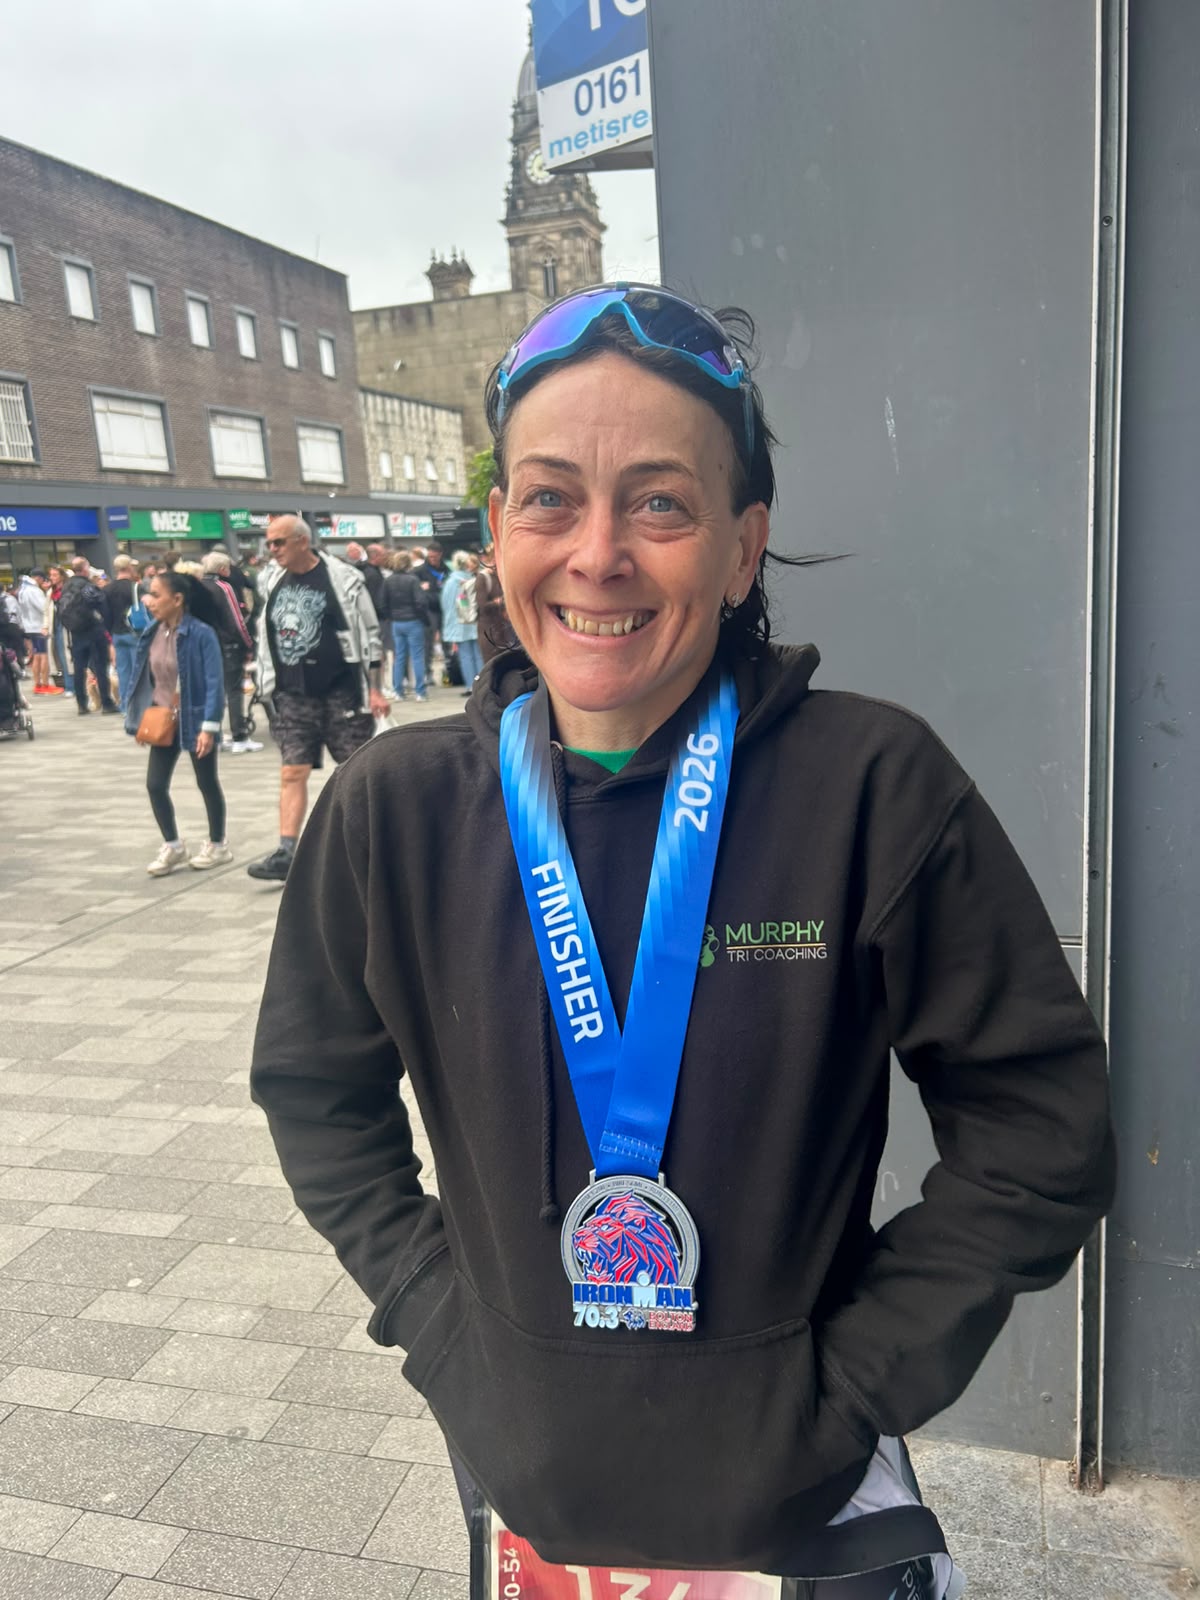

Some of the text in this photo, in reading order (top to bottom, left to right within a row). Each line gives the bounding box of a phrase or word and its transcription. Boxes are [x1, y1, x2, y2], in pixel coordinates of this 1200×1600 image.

[574, 59, 641, 117] 0161
[548, 109, 649, 159] metisre
[674, 733, 720, 832] 2026
[725, 919, 825, 945] MURPHY
[531, 859, 605, 1044] FINISHER
[726, 946, 828, 963] TRI COACHING
[573, 1273, 693, 1310] IRONMAN
[573, 1304, 620, 1330] 70.3
[648, 1310, 694, 1322] BOLTON
[648, 1320, 694, 1333] ENGLAND
[503, 1547, 521, 1600] 0-54
